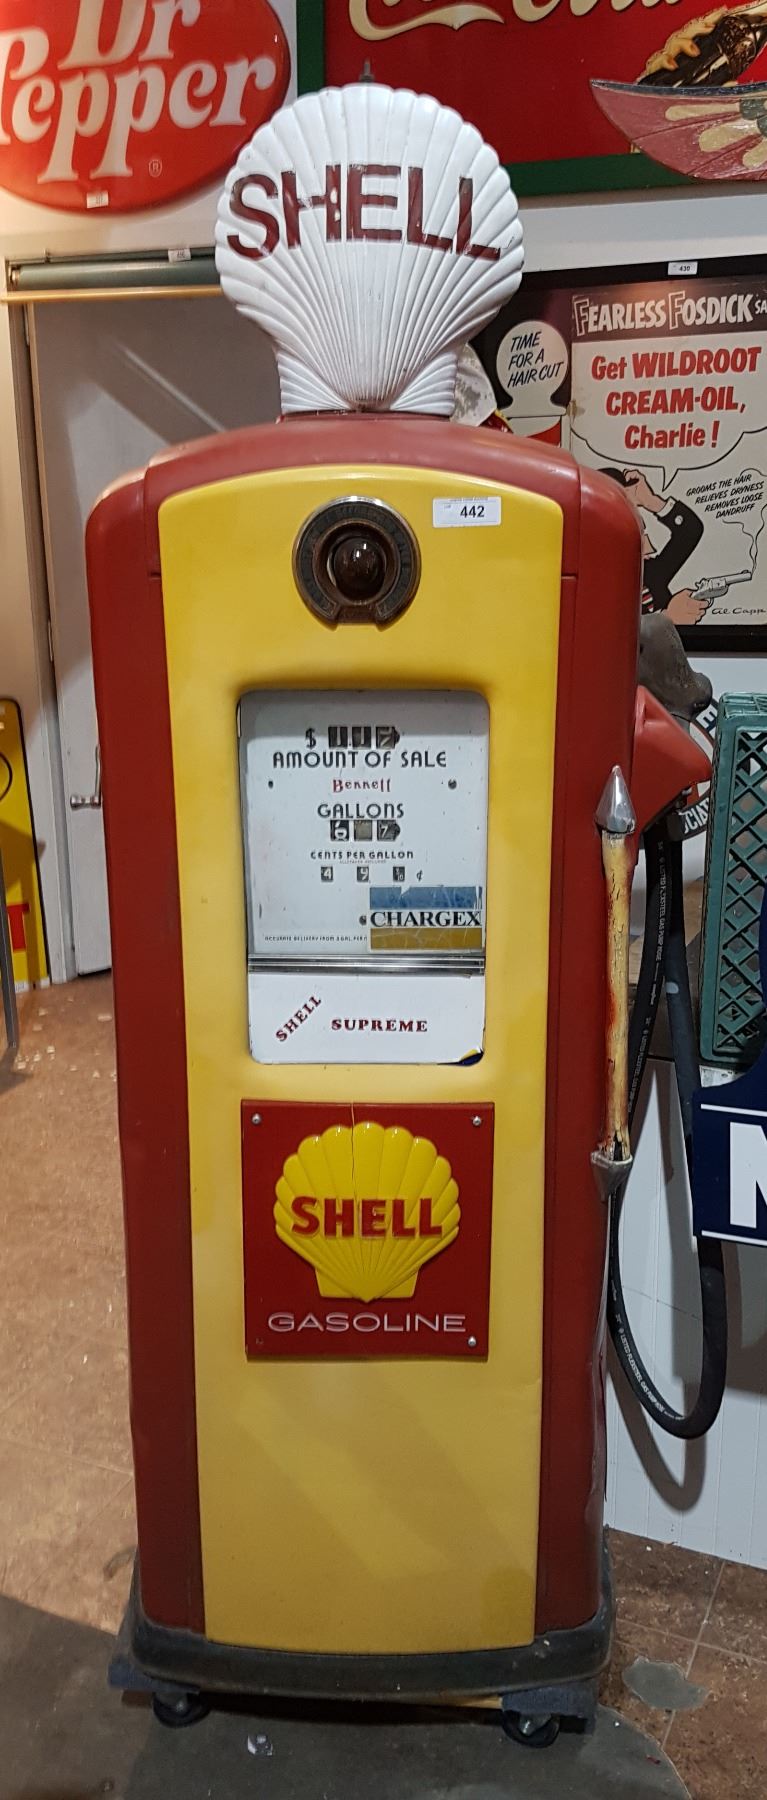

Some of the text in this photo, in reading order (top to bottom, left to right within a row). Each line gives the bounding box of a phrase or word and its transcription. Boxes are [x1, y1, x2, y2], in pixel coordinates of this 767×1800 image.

[57, 0, 200, 70] Dr
[0, 26, 277, 184] Pepper
[226, 163, 501, 261] SHELL
[574, 297, 667, 336] FEARLESS
[668, 290, 754, 331] FOSDICK
[511, 331, 542, 352] TIME
[508, 348, 545, 370] FOR A
[591, 346, 762, 381] Get WILDROOT
[606, 386, 746, 416] CREAM-OIL,
[686, 474, 752, 497] GROOMS THE HAIR
[694, 482, 764, 505] RELIEVES DRYNESS
[460, 505, 485, 518] 442
[704, 492, 763, 513] REMOVES LOOSE
[715, 503, 755, 519] DANDRUFF
[305, 727, 317, 749] $
[272, 750, 447, 769] AMOUNT OF SALE
[317, 803, 404, 819] GALLONS
[310, 851, 414, 860] CENTS PER GALLON
[370, 911, 481, 927] CHARGEX
[275, 995, 322, 1042] SHELL
[331, 1018, 428, 1033] SUPREME
[291, 1196, 443, 1238] SHELL
[267, 1312, 466, 1333] GASOLINE
